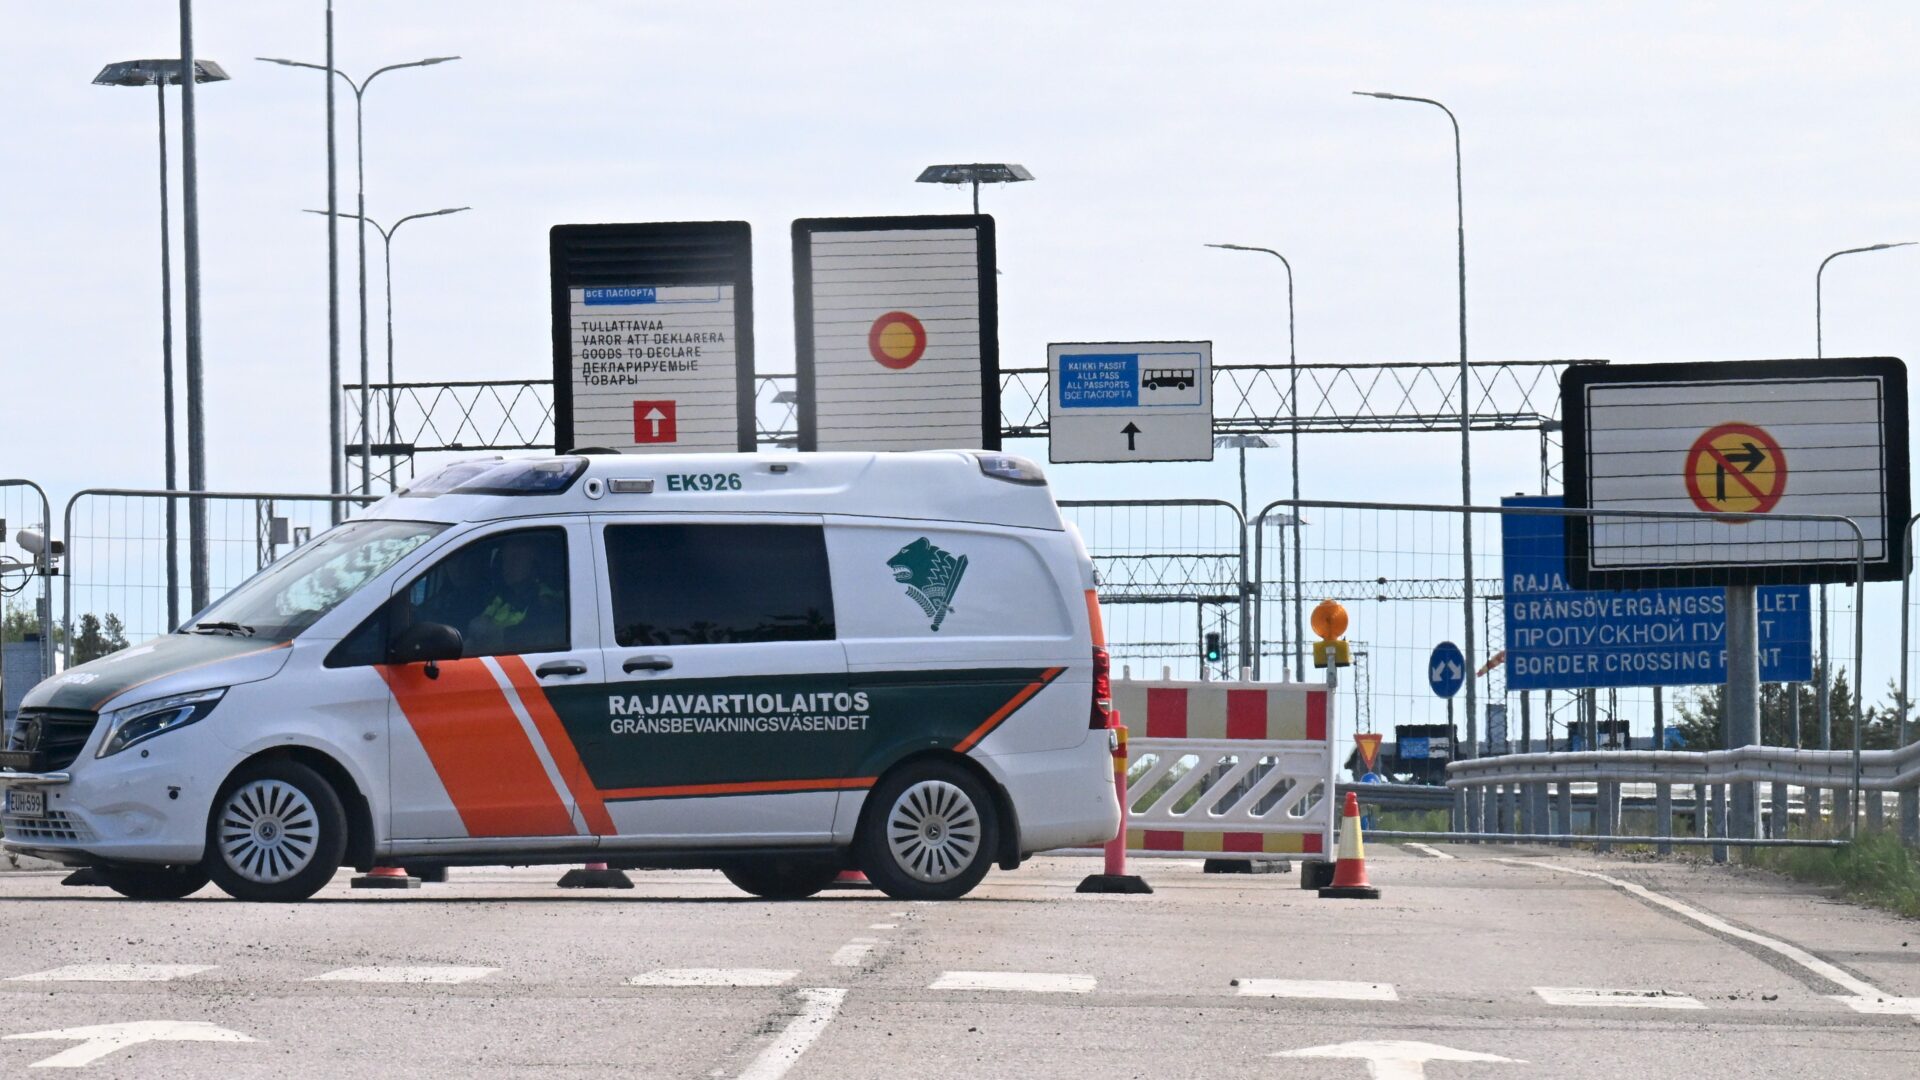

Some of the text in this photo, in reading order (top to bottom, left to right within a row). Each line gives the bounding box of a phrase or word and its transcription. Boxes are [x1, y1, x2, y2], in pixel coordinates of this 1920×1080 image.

[586, 289, 654, 298] ВСЕ ПАСПОРТА
[582, 320, 664, 332] TULLATTAVAA
[582, 332, 725, 346] VAROR ATT DEKLARERA
[582, 346, 701, 359] GOODS TO DECLARE
[582, 360, 698, 375] ДЕКЛАРИРУЕМЫЕ
[1068, 361, 1127, 370] KAIKKI PASSIT
[583, 374, 638, 386] ТОВАРЫ
[1077, 371, 1120, 380] ALLA PASS
[1067, 381, 1130, 389] ALL PASSPORTS
[1064, 390, 1133, 400] ВСЕ ПАСПОРТА
[666, 473, 742, 491] EK926
[1514, 592, 1800, 620] GRÄNSÖVERGÅNGSSLET
[1515, 618, 1775, 647] ПРОПУСКНОЙ ПУТ
[1515, 647, 1782, 676] BORDER CROSSING PNT
[608, 692, 870, 715] RAJAVARTIOLAITOS
[610, 713, 870, 734] GRÄNSBEVAKNINGSVÄSENDET
[11, 793, 41, 812] EUH-599
